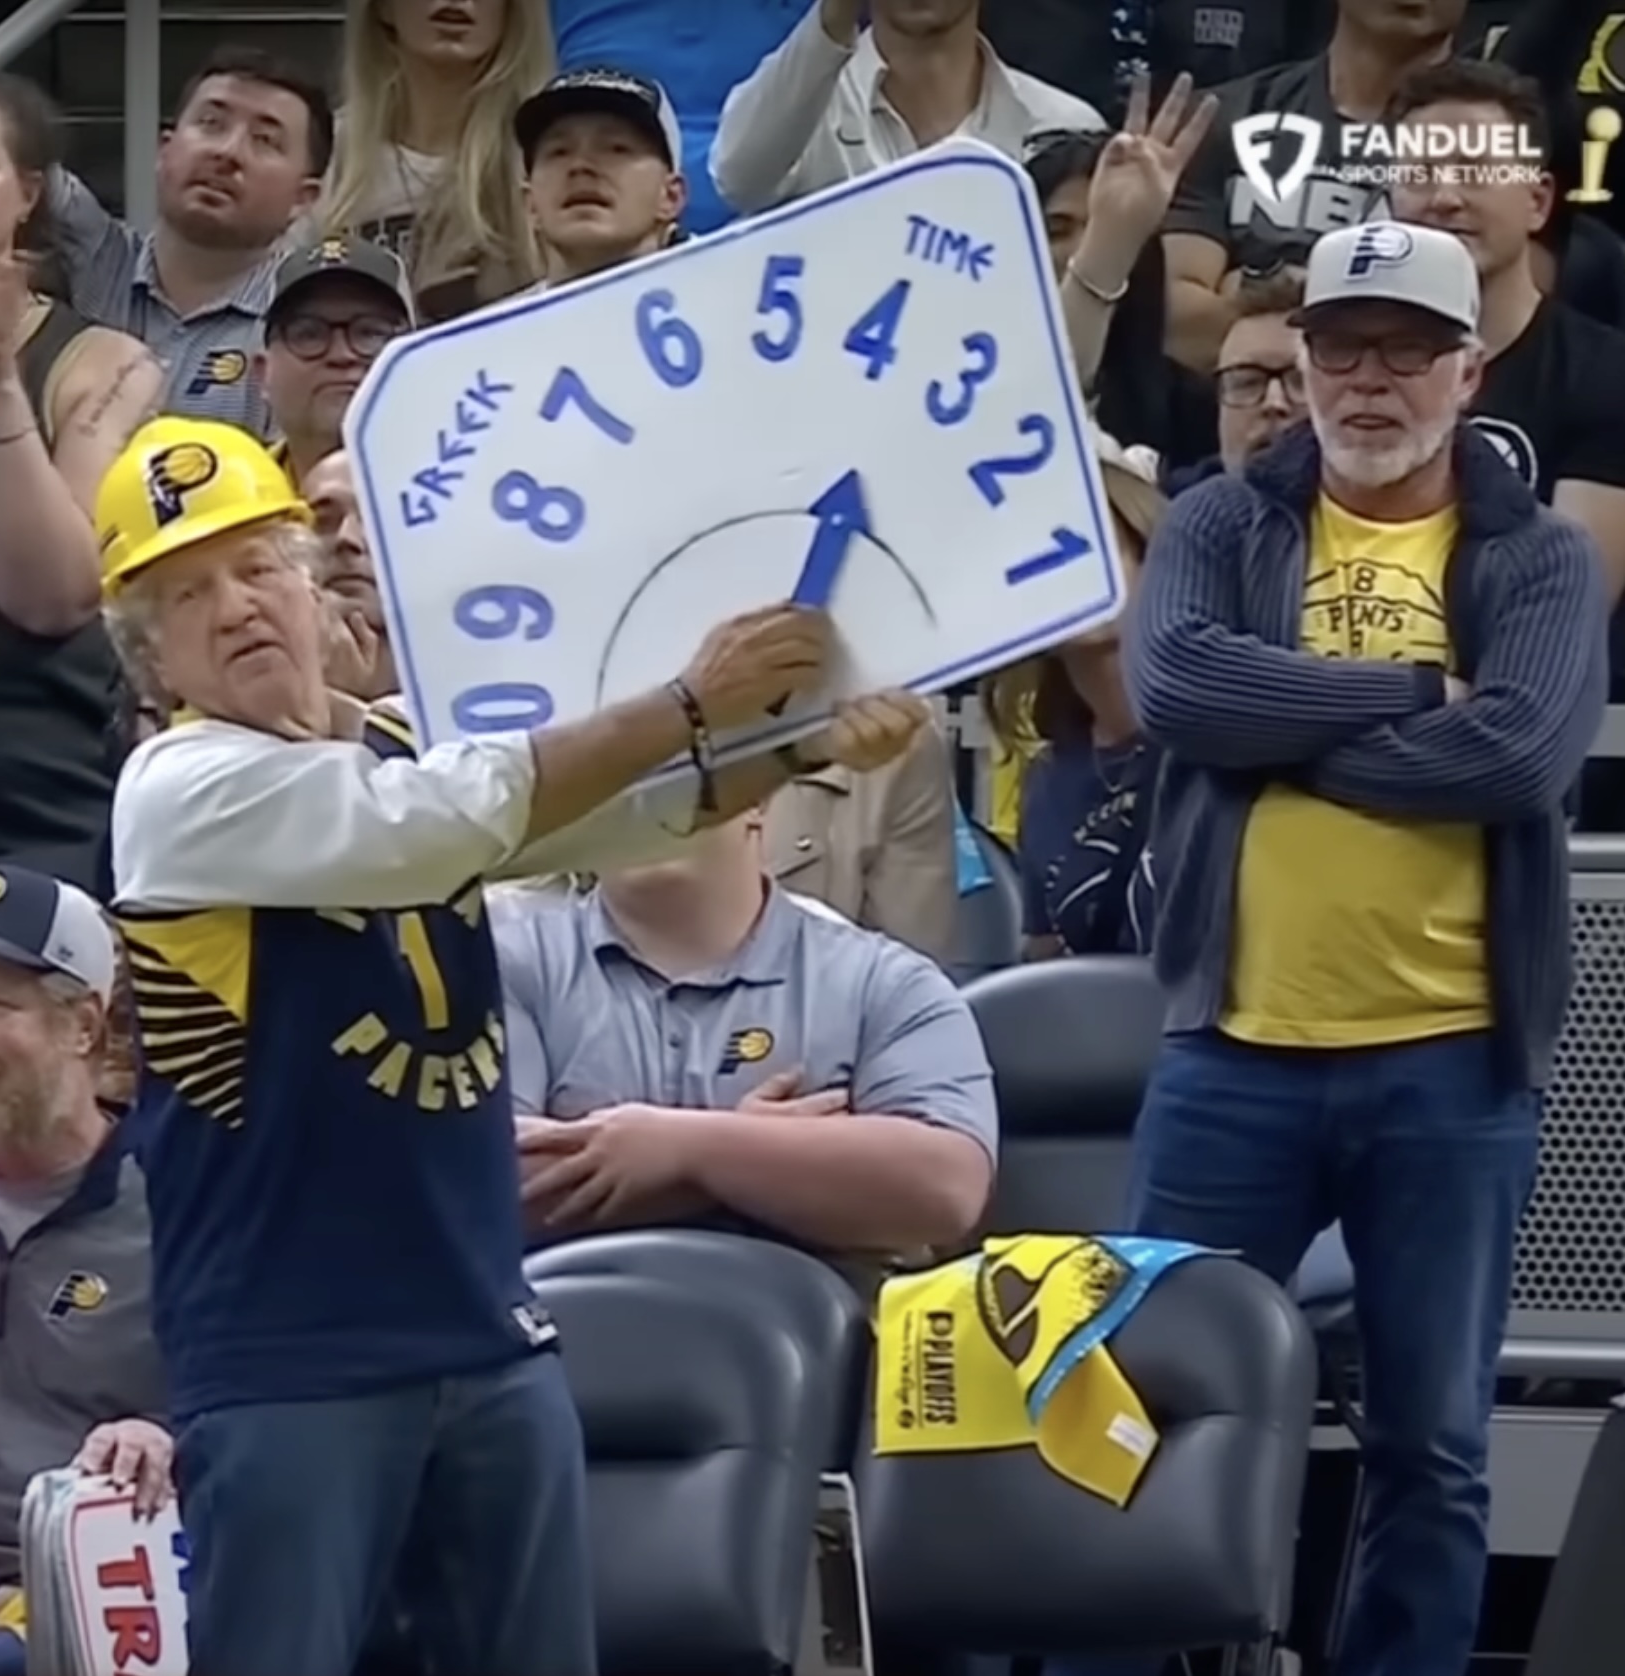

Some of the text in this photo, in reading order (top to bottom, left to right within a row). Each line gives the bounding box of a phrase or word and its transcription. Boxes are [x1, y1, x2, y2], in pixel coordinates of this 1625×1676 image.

[905, 214, 995, 282] TIME
[634, 288, 704, 389] 6
[751, 254, 806, 364] 5
[842, 279, 912, 382] 4
[538, 366, 634, 446] 7
[923, 331, 999, 427] 3
[967, 413, 1057, 509] 2
[491, 469, 586, 545] 8
[1004, 526, 1093, 587] 1
[1354, 565, 1377, 592] 8
[453, 584, 555, 641] 9
[96, 1543, 162, 1676] TR
